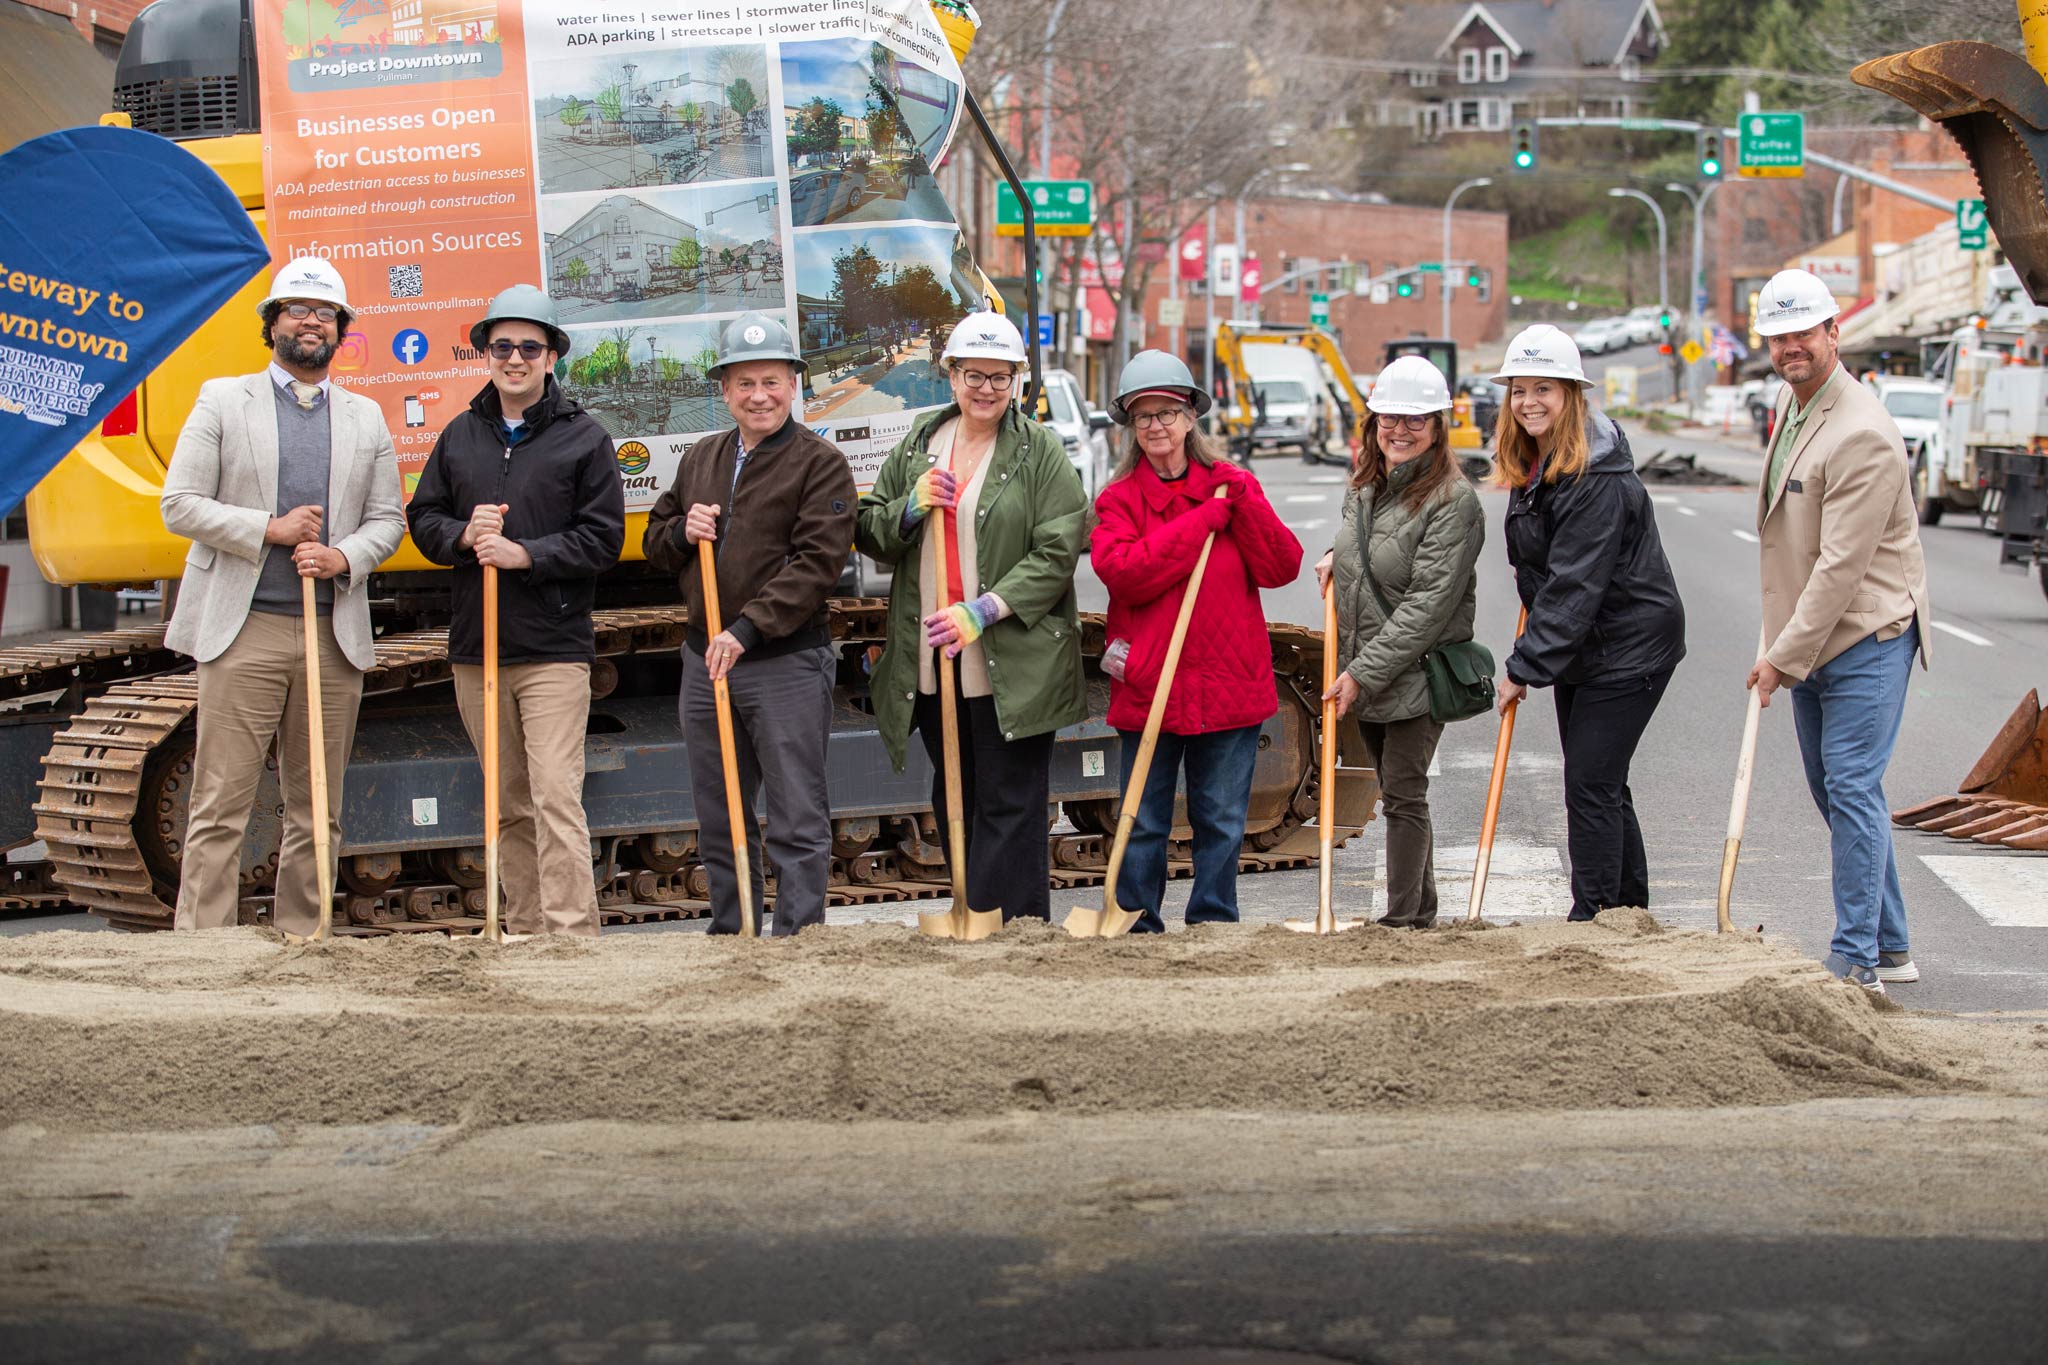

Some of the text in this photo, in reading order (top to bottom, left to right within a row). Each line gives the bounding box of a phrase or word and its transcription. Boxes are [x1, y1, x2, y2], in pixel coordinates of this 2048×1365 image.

[557, 0, 945, 47] water lines sewer lines stormwater lines sidewalks stree
[566, 16, 941, 66] ADA parking streetscape slower traffic bike connectivity
[309, 51, 484, 78] Project Downtown
[377, 72, 413, 83] Pullman
[297, 105, 496, 138] Businesses Open
[314, 141, 482, 170] for Customers
[275, 166, 526, 197] ADA pedestrian access to businesses
[288, 191, 516, 221] maintained through construction
[288, 230, 522, 262] Information Sources
[0, 262, 145, 322] teway to
[353, 297, 495, 316] jectdowntownpullman.o
[0, 312, 129, 363] wntown
[0, 364, 104, 402] HAMBER of
[333, 366, 491, 387] @ProjectDowntownPullma
[0, 381, 90, 416] OMMERCE
[420, 392, 440, 400] SMS
[401, 434, 414, 445] to
[416, 431, 443, 444] 599
[873, 424, 910, 436] BERNARDO
[396, 452, 429, 463] etters
[850, 463, 880, 473] the City
